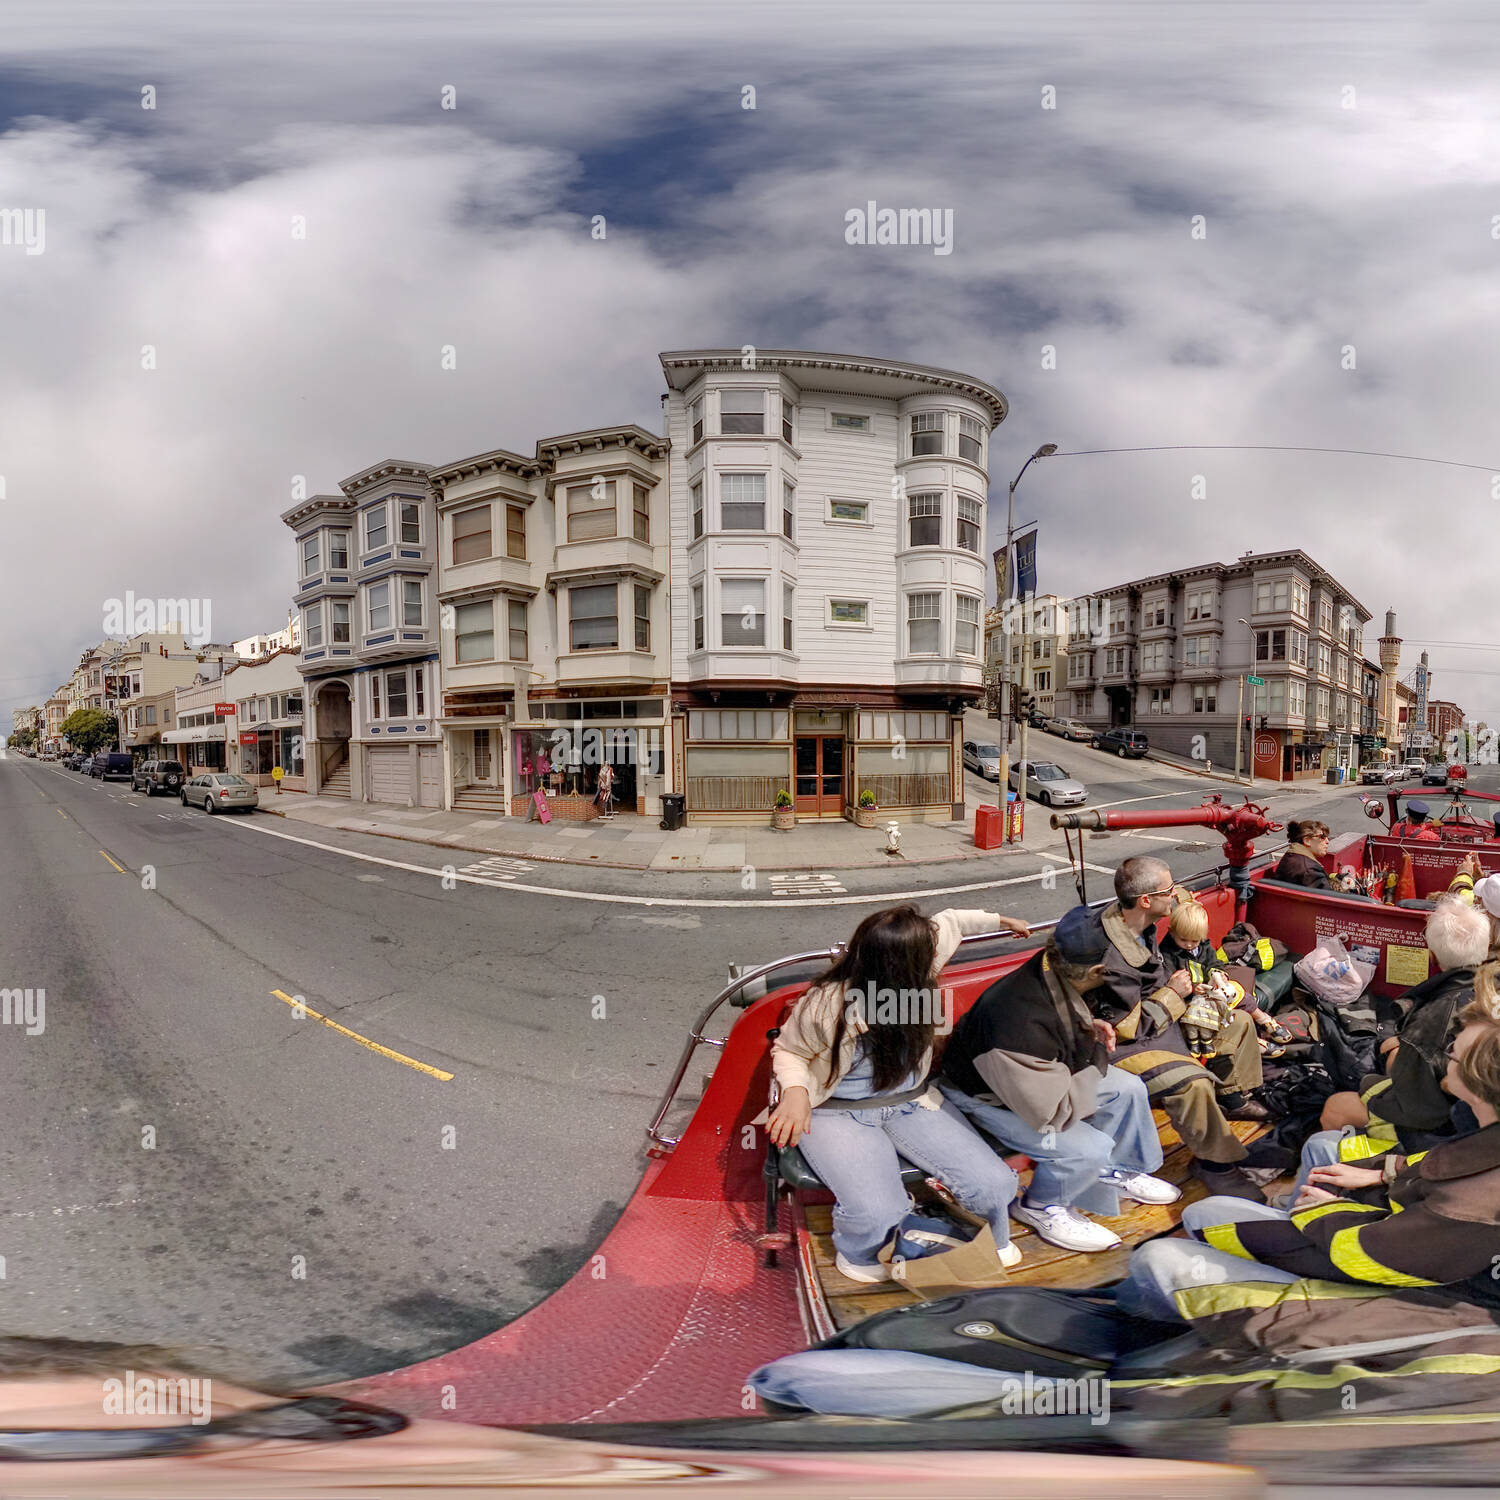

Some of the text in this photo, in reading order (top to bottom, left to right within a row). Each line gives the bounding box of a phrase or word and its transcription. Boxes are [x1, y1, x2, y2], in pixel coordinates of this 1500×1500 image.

[1256, 742, 1275, 754] TONIC
[1376, 926, 1403, 934] COMFORT
[1374, 935, 1401, 943] WITHOUT
